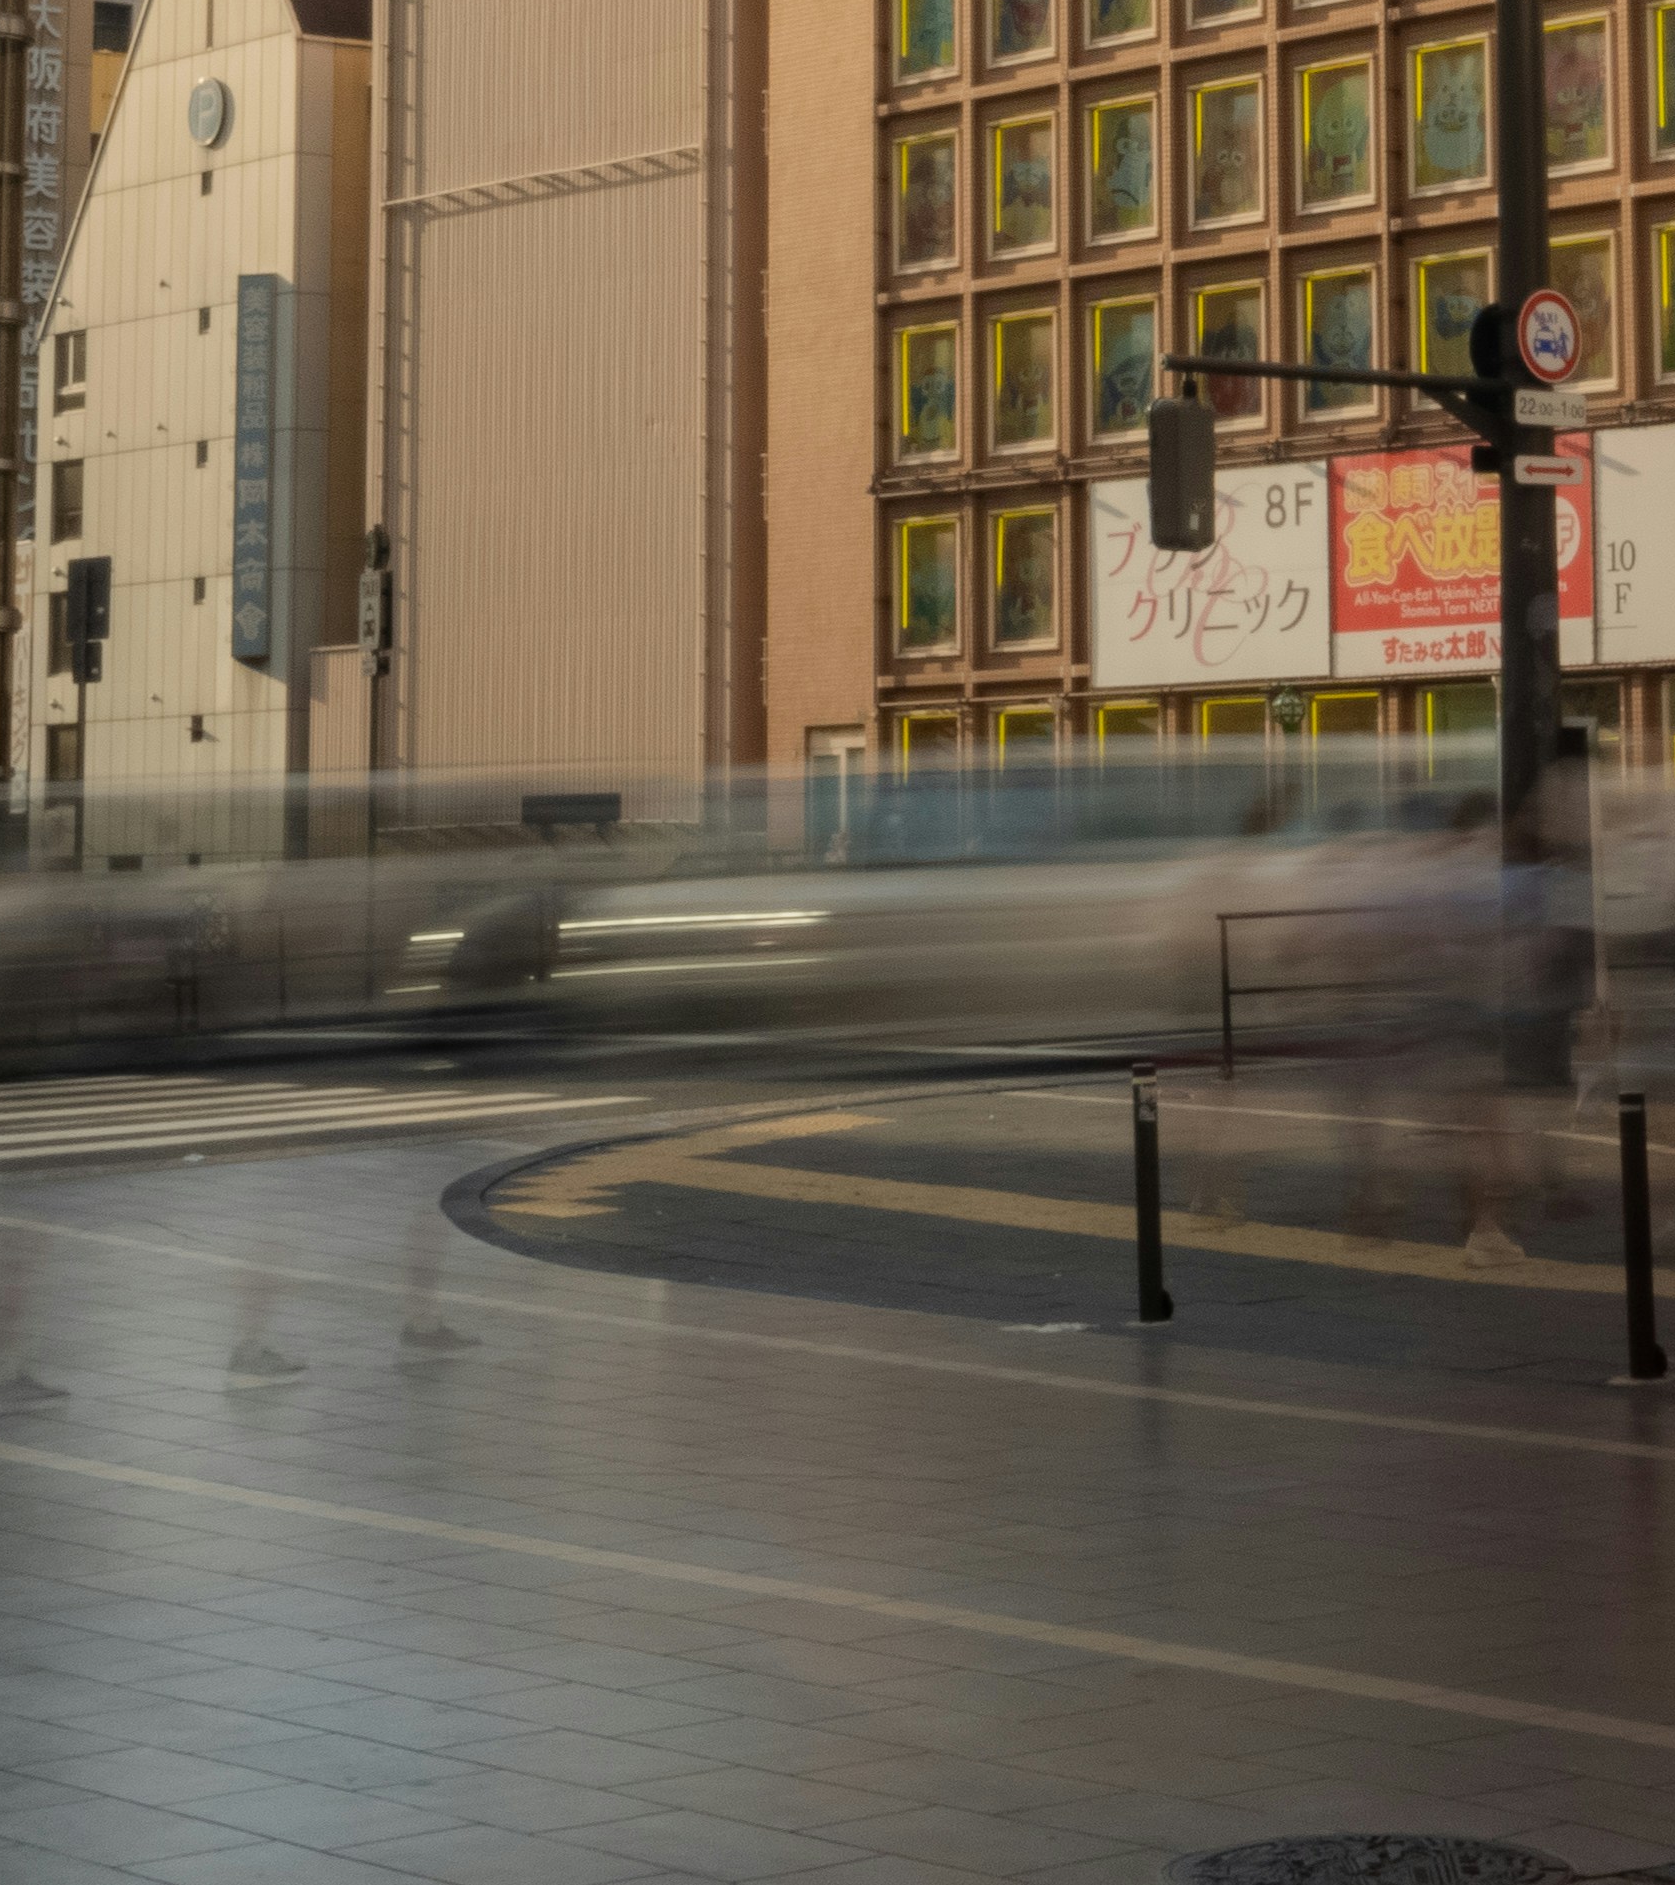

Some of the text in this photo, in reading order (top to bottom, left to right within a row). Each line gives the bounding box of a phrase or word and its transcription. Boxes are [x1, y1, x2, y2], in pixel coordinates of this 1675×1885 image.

[1265, 481, 1314, 529] 8F
[1127, 580, 1311, 643] クリニック
[1469, 597, 1500, 615] NEXT
[1381, 629, 1486, 665] すたみな太郎
